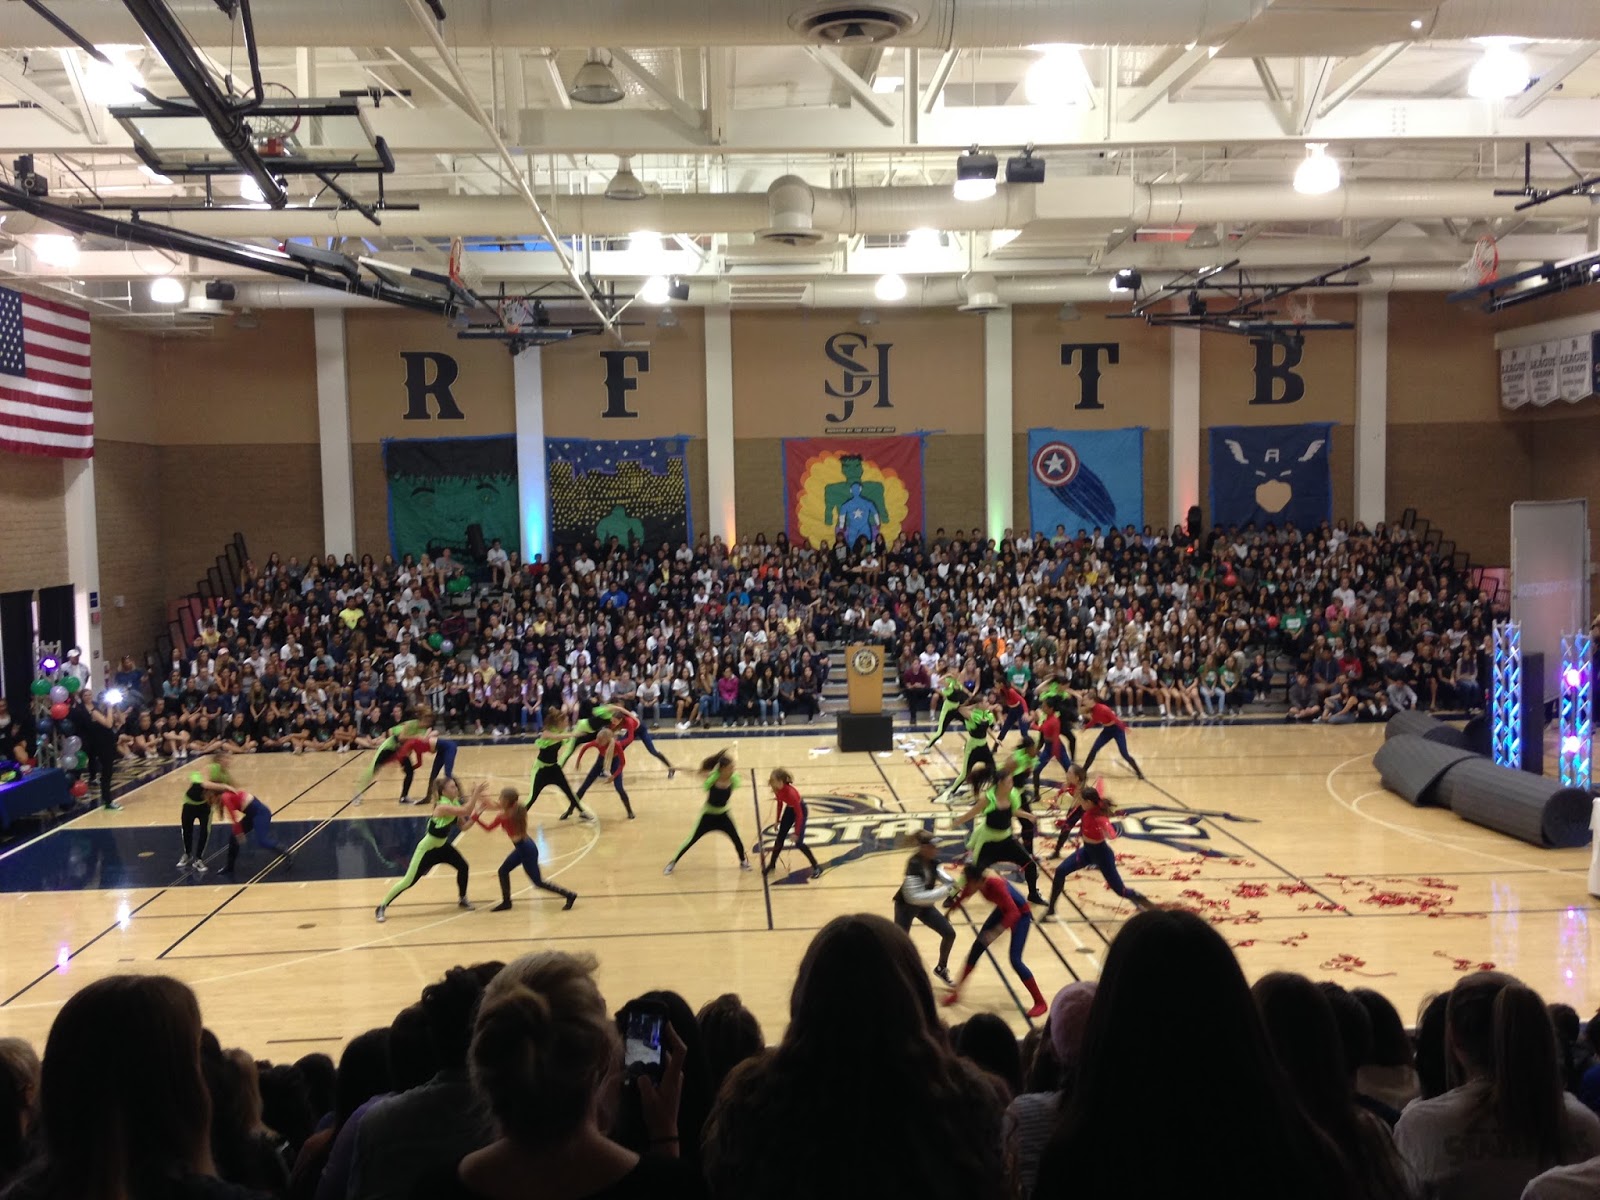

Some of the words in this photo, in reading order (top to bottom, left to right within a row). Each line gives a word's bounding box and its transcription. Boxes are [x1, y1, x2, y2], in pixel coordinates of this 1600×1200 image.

[400, 351, 465, 420] R
[600, 351, 649, 418] F
[1060, 342, 1119, 410] T
[1248, 338, 1305, 405] B
[1530, 357, 1556, 370] LEAGUE
[1560, 352, 1588, 366] LEAGUE
[1264, 448, 1280, 463] A
